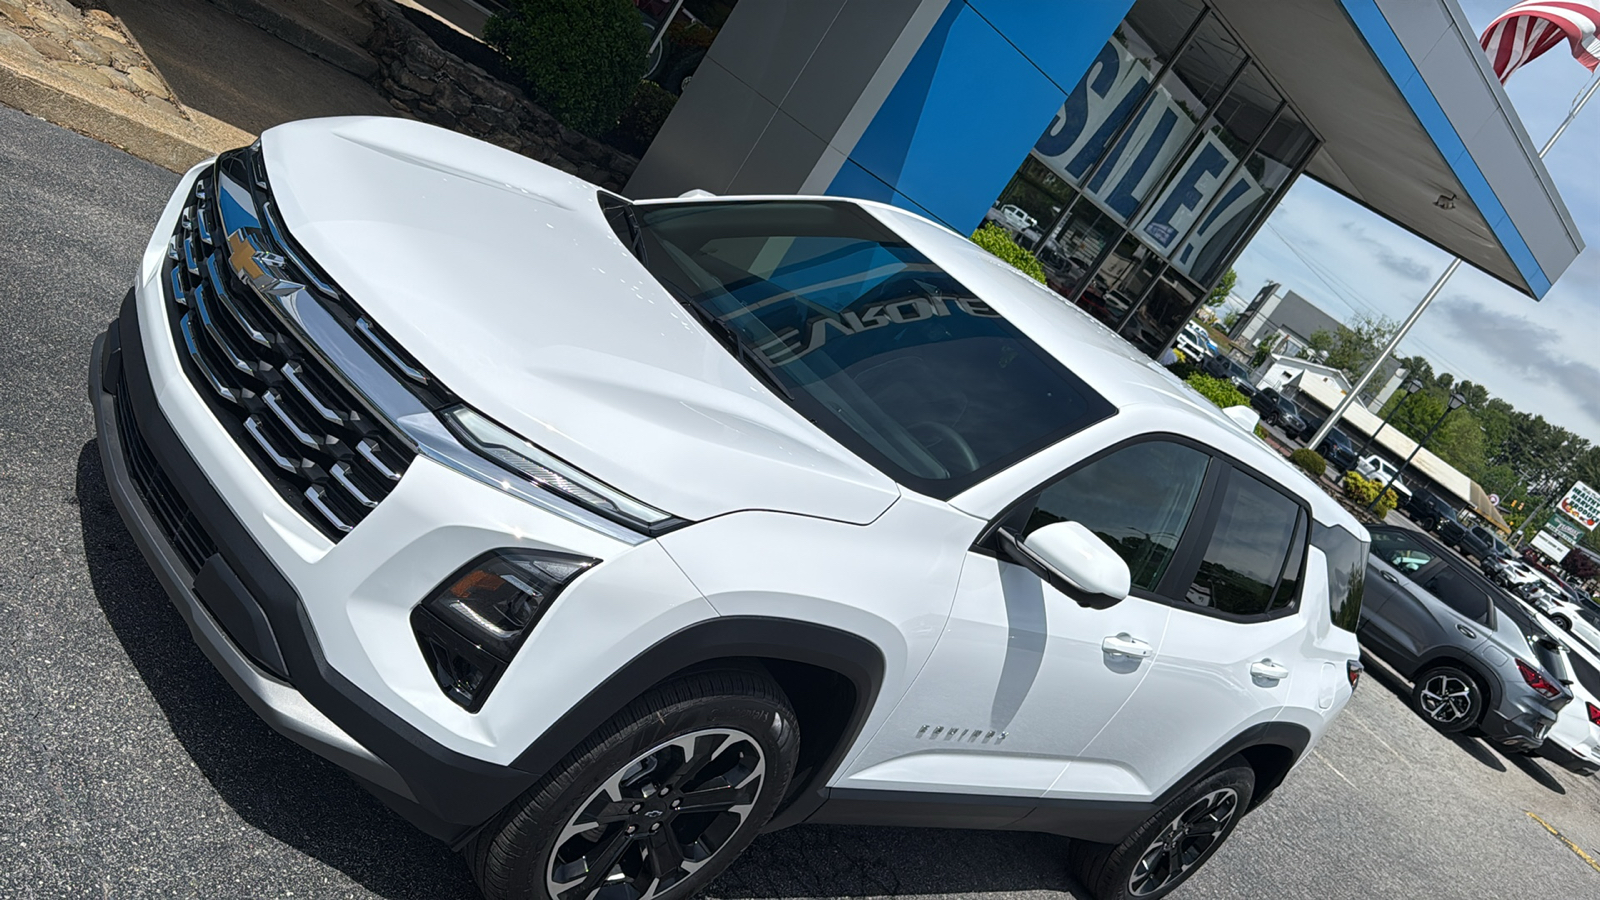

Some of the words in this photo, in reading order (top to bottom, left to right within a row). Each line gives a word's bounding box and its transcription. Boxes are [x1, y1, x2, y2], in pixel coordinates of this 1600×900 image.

[1571, 494, 1600, 516] HARVEST
[1572, 487, 1600, 508] HEALTHY
[1569, 500, 1599, 522] PRODUCE
